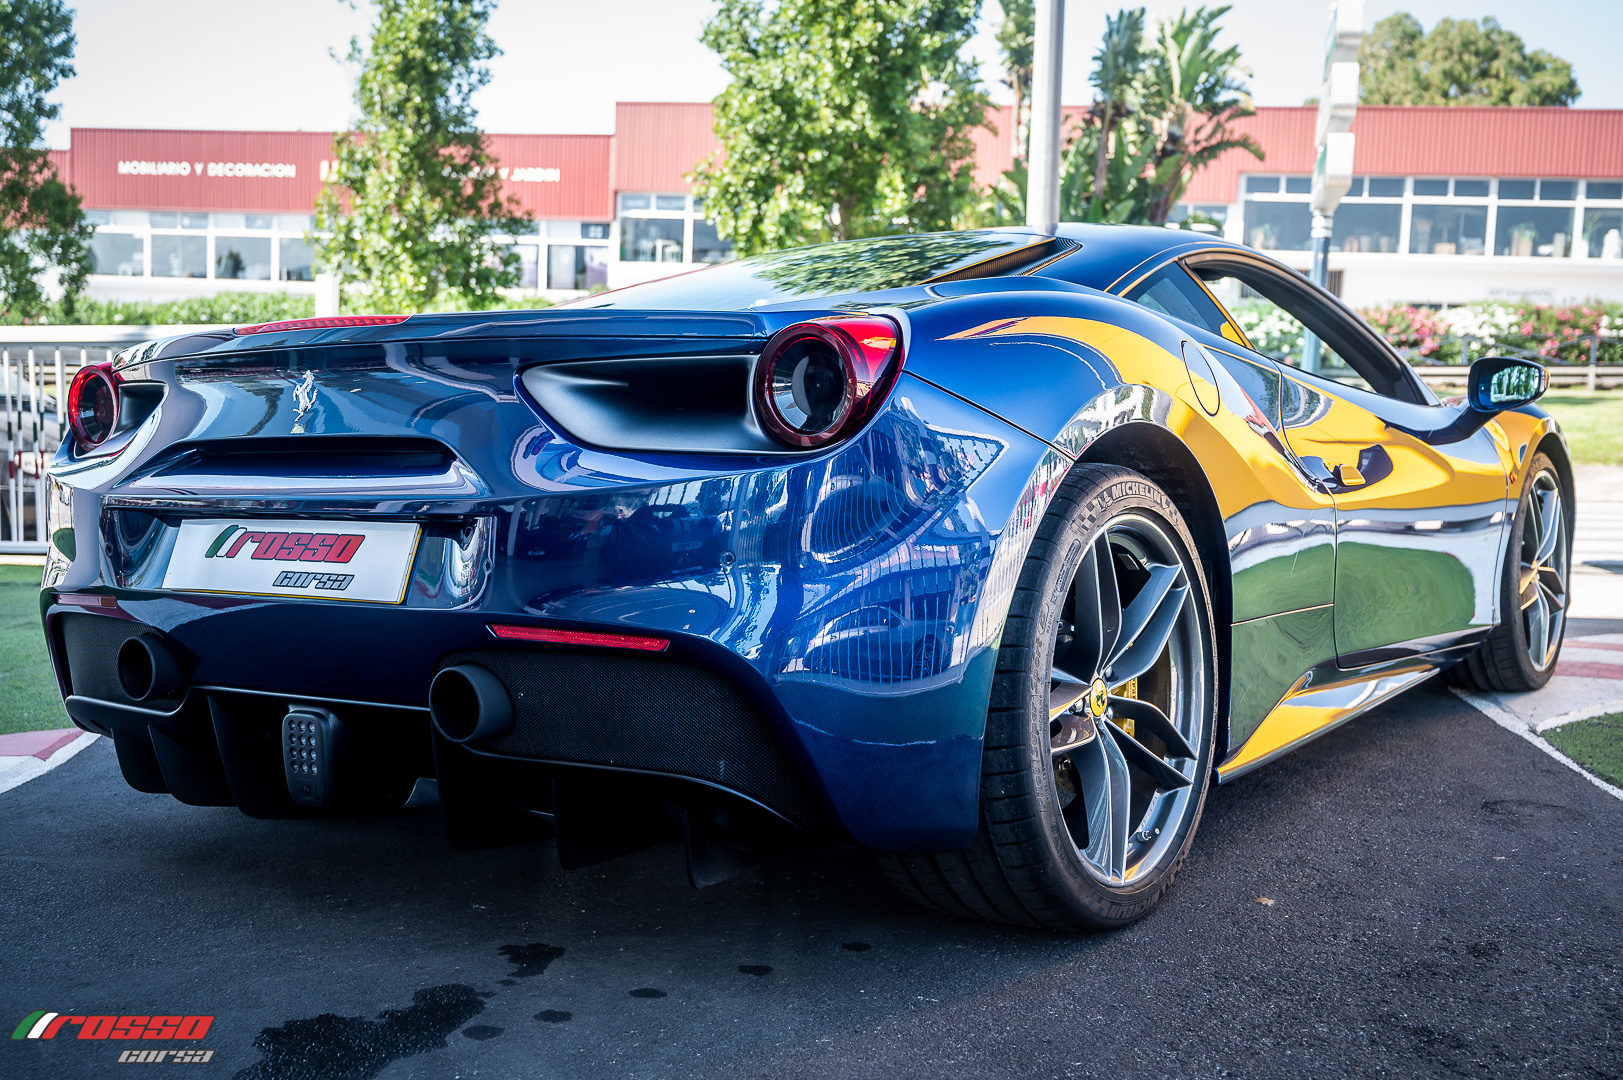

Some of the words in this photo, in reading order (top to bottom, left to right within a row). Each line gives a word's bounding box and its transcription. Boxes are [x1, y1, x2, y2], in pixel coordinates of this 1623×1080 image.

[117, 160, 191, 175] MOBILIARIO
[194, 162, 204, 176] Y
[207, 162, 296, 178] DECORACION
[510, 167, 560, 182] JARDIN
[1111, 482, 1163, 504] MICHELIN
